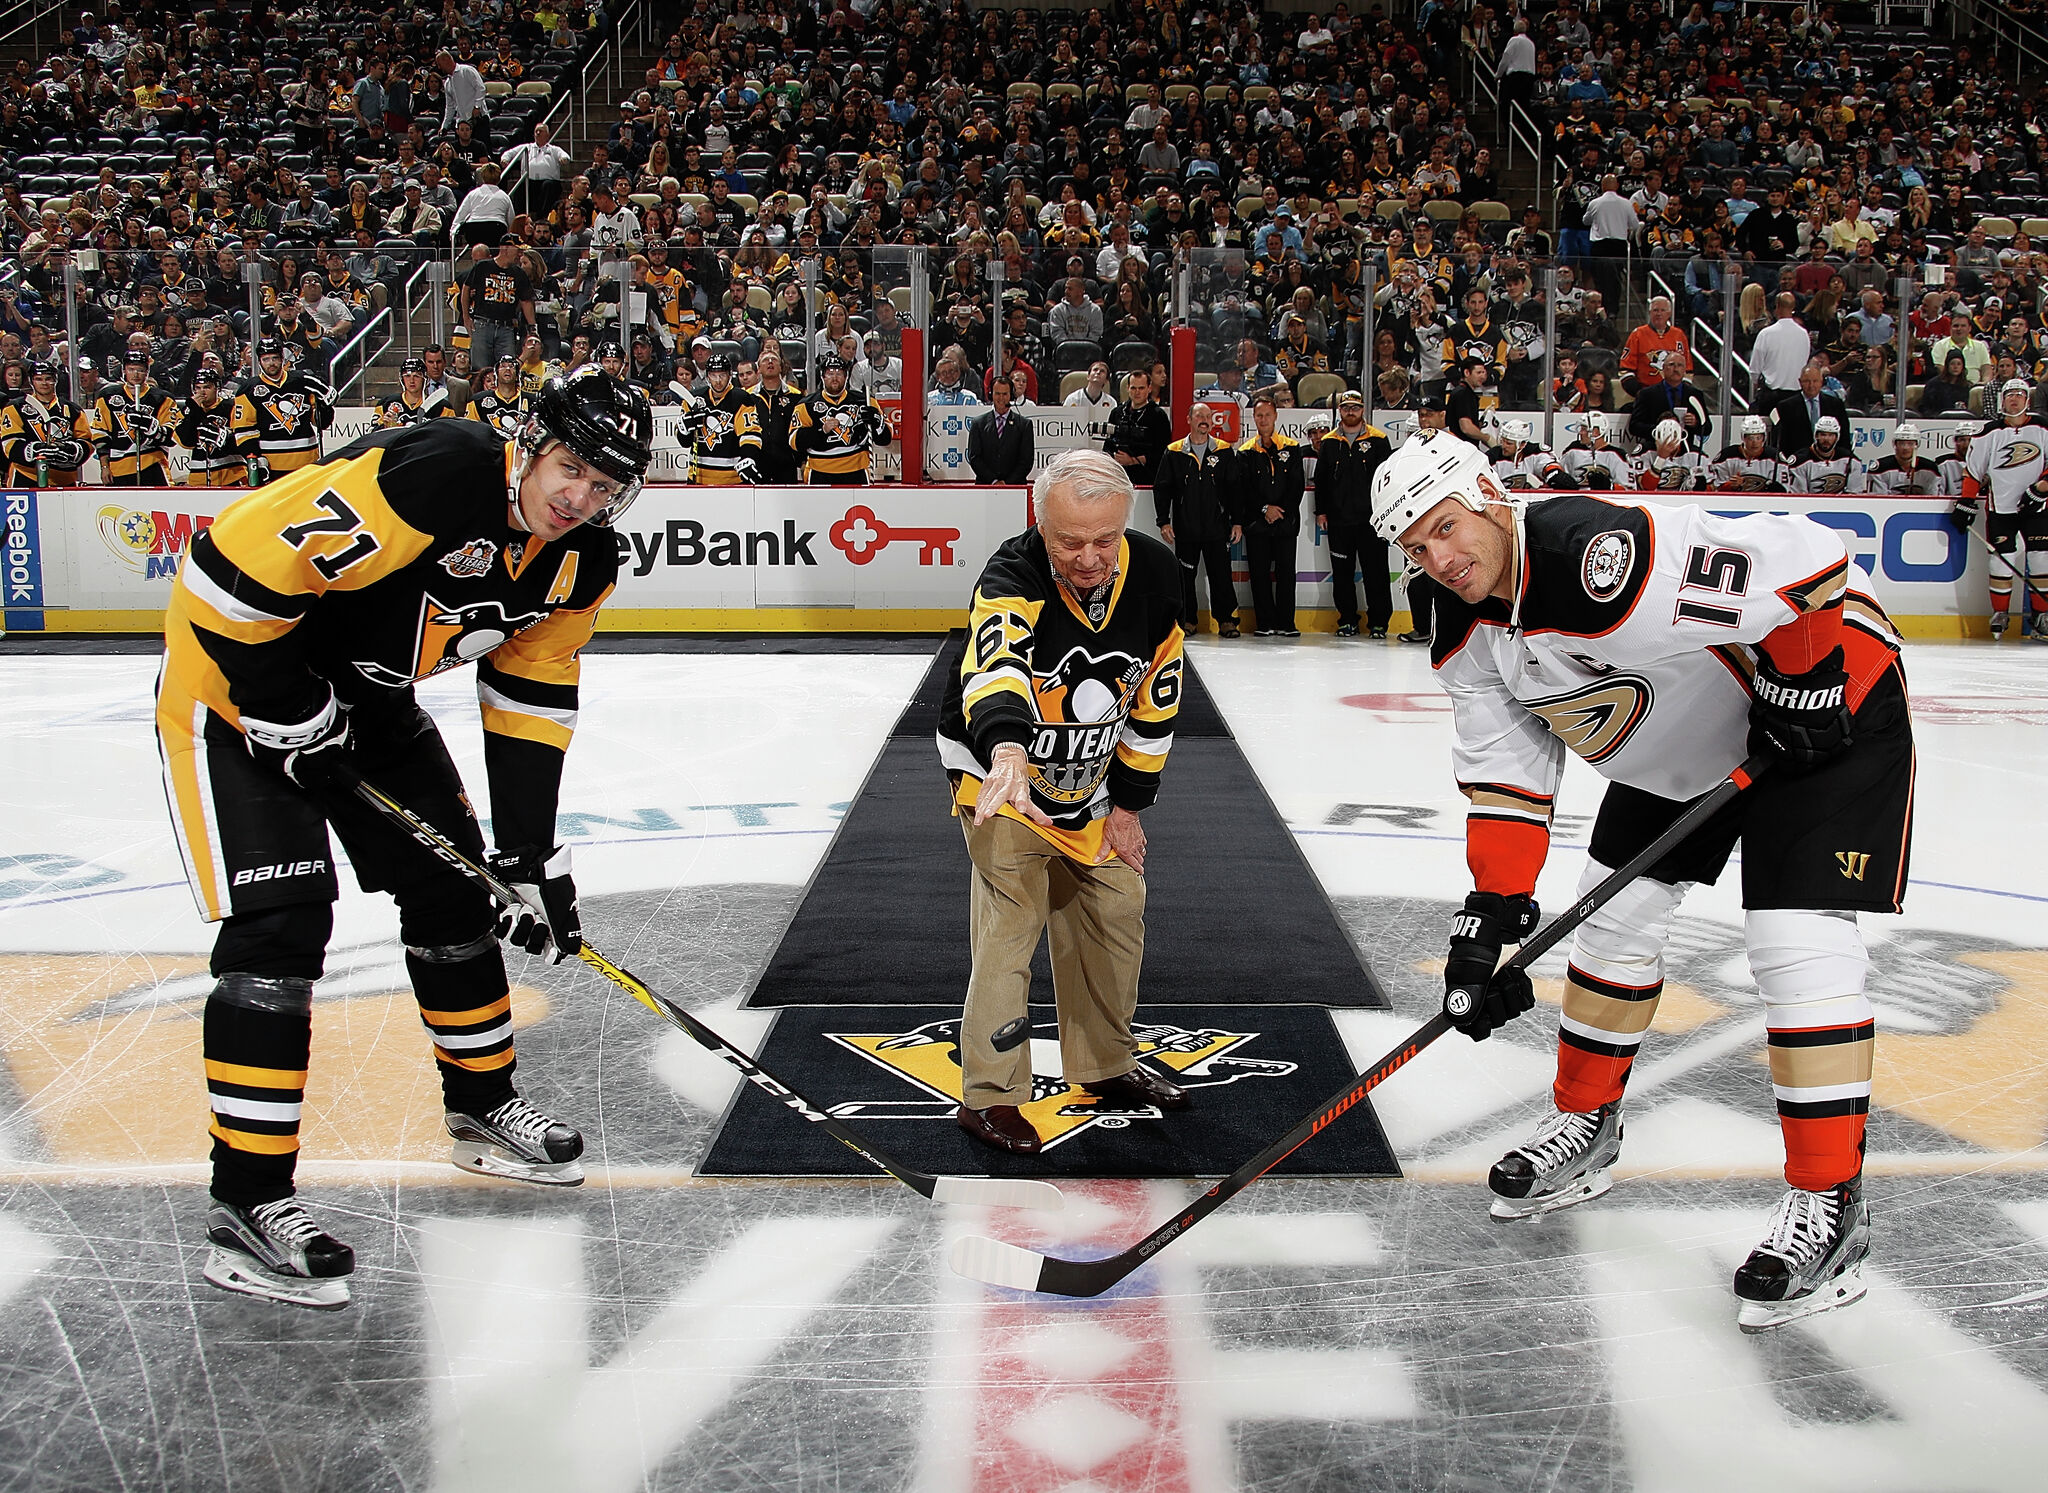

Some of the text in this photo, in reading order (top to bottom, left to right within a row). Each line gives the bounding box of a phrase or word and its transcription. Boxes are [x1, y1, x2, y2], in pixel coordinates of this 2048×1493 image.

[484, 287, 516, 304] 2016
[94, 407, 102, 422] 4
[235, 405, 243, 420] 5
[617, 412, 638, 440] 71
[1212, 413, 1224, 426] G
[600, 444, 637, 467] BAUER
[1377, 470, 1392, 494] 15
[1379, 493, 1406, 522] BAUER
[6, 495, 34, 601] Reebok
[276, 485, 383, 583] 71
[616, 519, 819, 577] eyBank
[450, 552, 488, 570] 50 YEARS
[544, 550, 580, 604] A
[1672, 543, 1753, 630] 15
[1753, 671, 1844, 710] ARRIOR
[1066, 721, 1123, 760] YEAR
[1031, 773, 1065, 799] 1967
[403, 809, 456, 847] CCM
[412, 830, 479, 878] CCM
[232, 859, 326, 887] BAUER
[1519, 912, 1530, 925] 15
[1578, 898, 1595, 918] QR
[568, 929, 582, 938] CC
[712, 1045, 830, 1123] CCM
[1311, 1043, 1418, 1136] WARRIOR
[1138, 1213, 1194, 1257] COVERT QR
